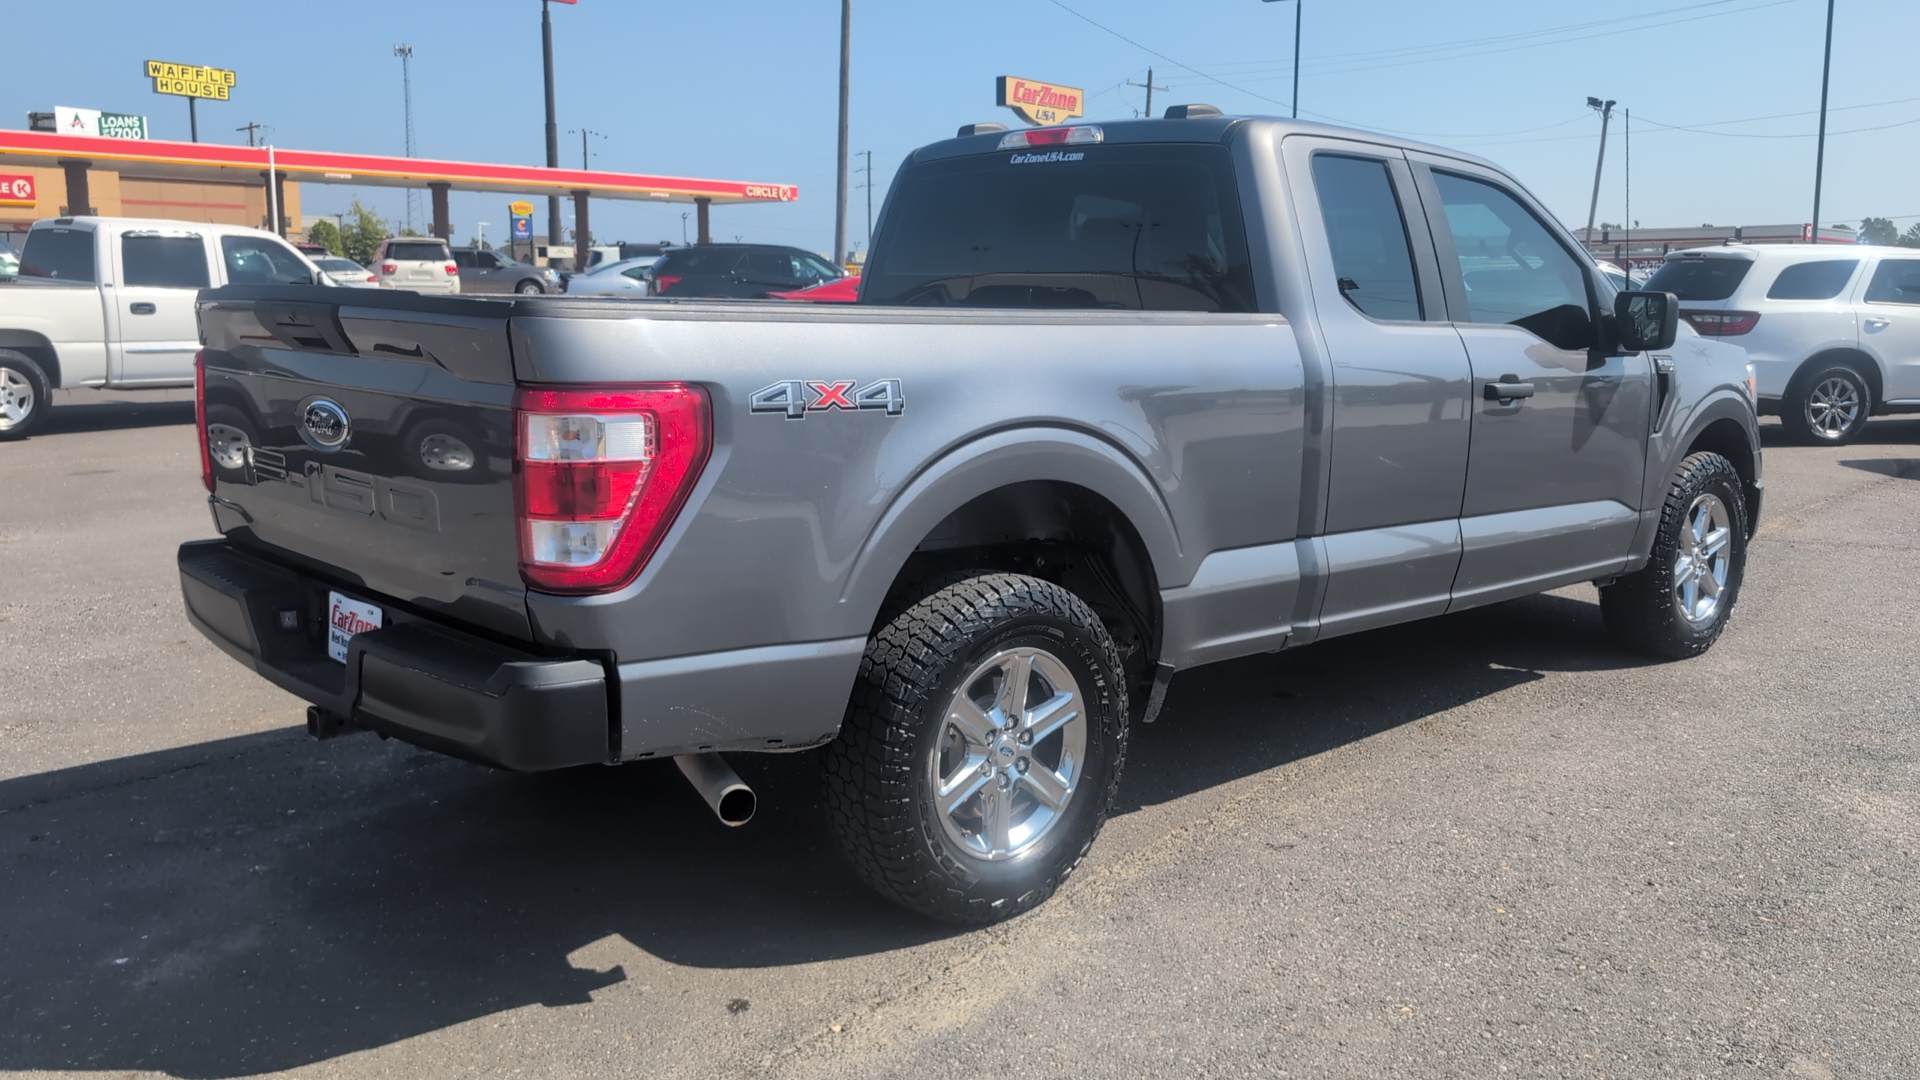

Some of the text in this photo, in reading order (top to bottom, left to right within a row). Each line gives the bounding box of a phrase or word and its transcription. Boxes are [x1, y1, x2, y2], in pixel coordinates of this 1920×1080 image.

[150, 63, 233, 84] WAFFLE
[159, 80, 227, 98] HOUSE
[1013, 81, 1078, 112] CarZone
[101, 116, 140, 128] LOANS
[1035, 109, 1056, 122] USA
[110, 128, 142, 139] $700
[1010, 151, 1084, 164] CarZoneUSA.com
[746, 185, 778, 198] CIRCLE
[309, 409, 337, 436] Ford
[243, 444, 441, 534] F-150
